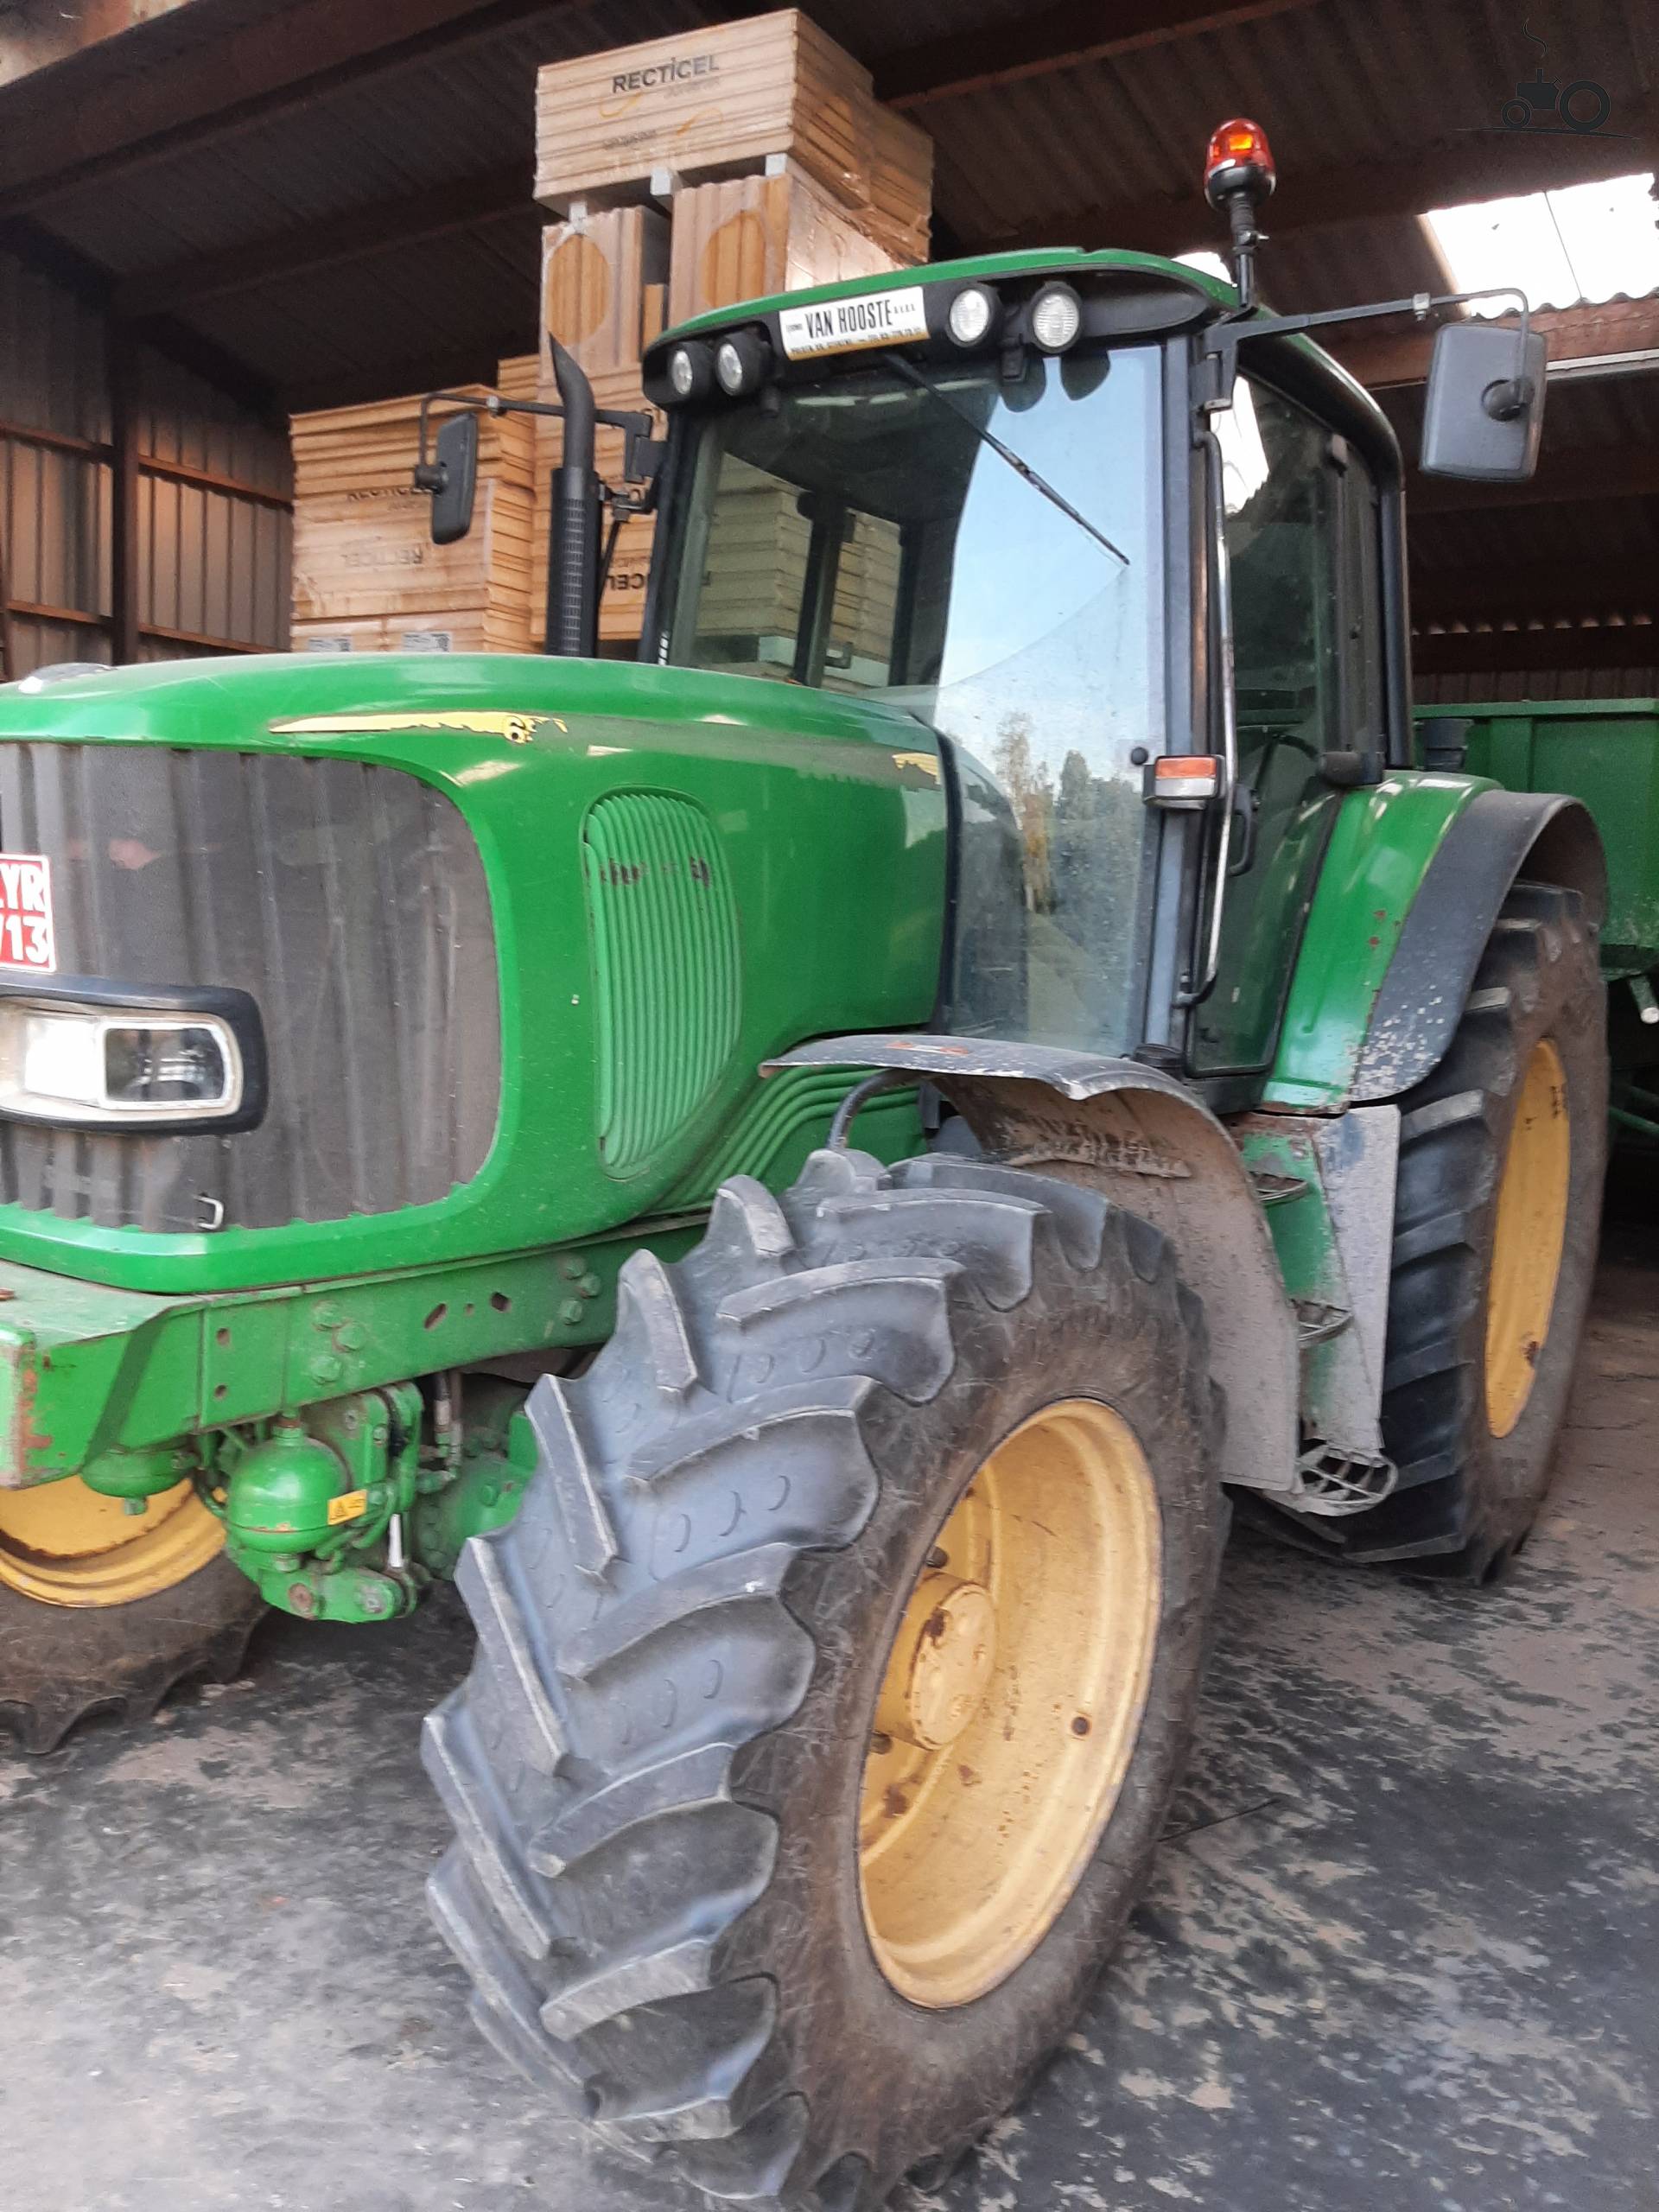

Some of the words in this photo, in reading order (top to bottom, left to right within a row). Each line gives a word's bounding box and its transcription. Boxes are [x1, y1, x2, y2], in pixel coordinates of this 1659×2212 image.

[612, 54, 720, 93] RECTICEL
[804, 309, 835, 339] VAN
[837, 299, 893, 334] HOOSTE
[607, 573, 646, 591] CEL
[0, 862, 44, 912] YR
[0, 913, 49, 964] 13
